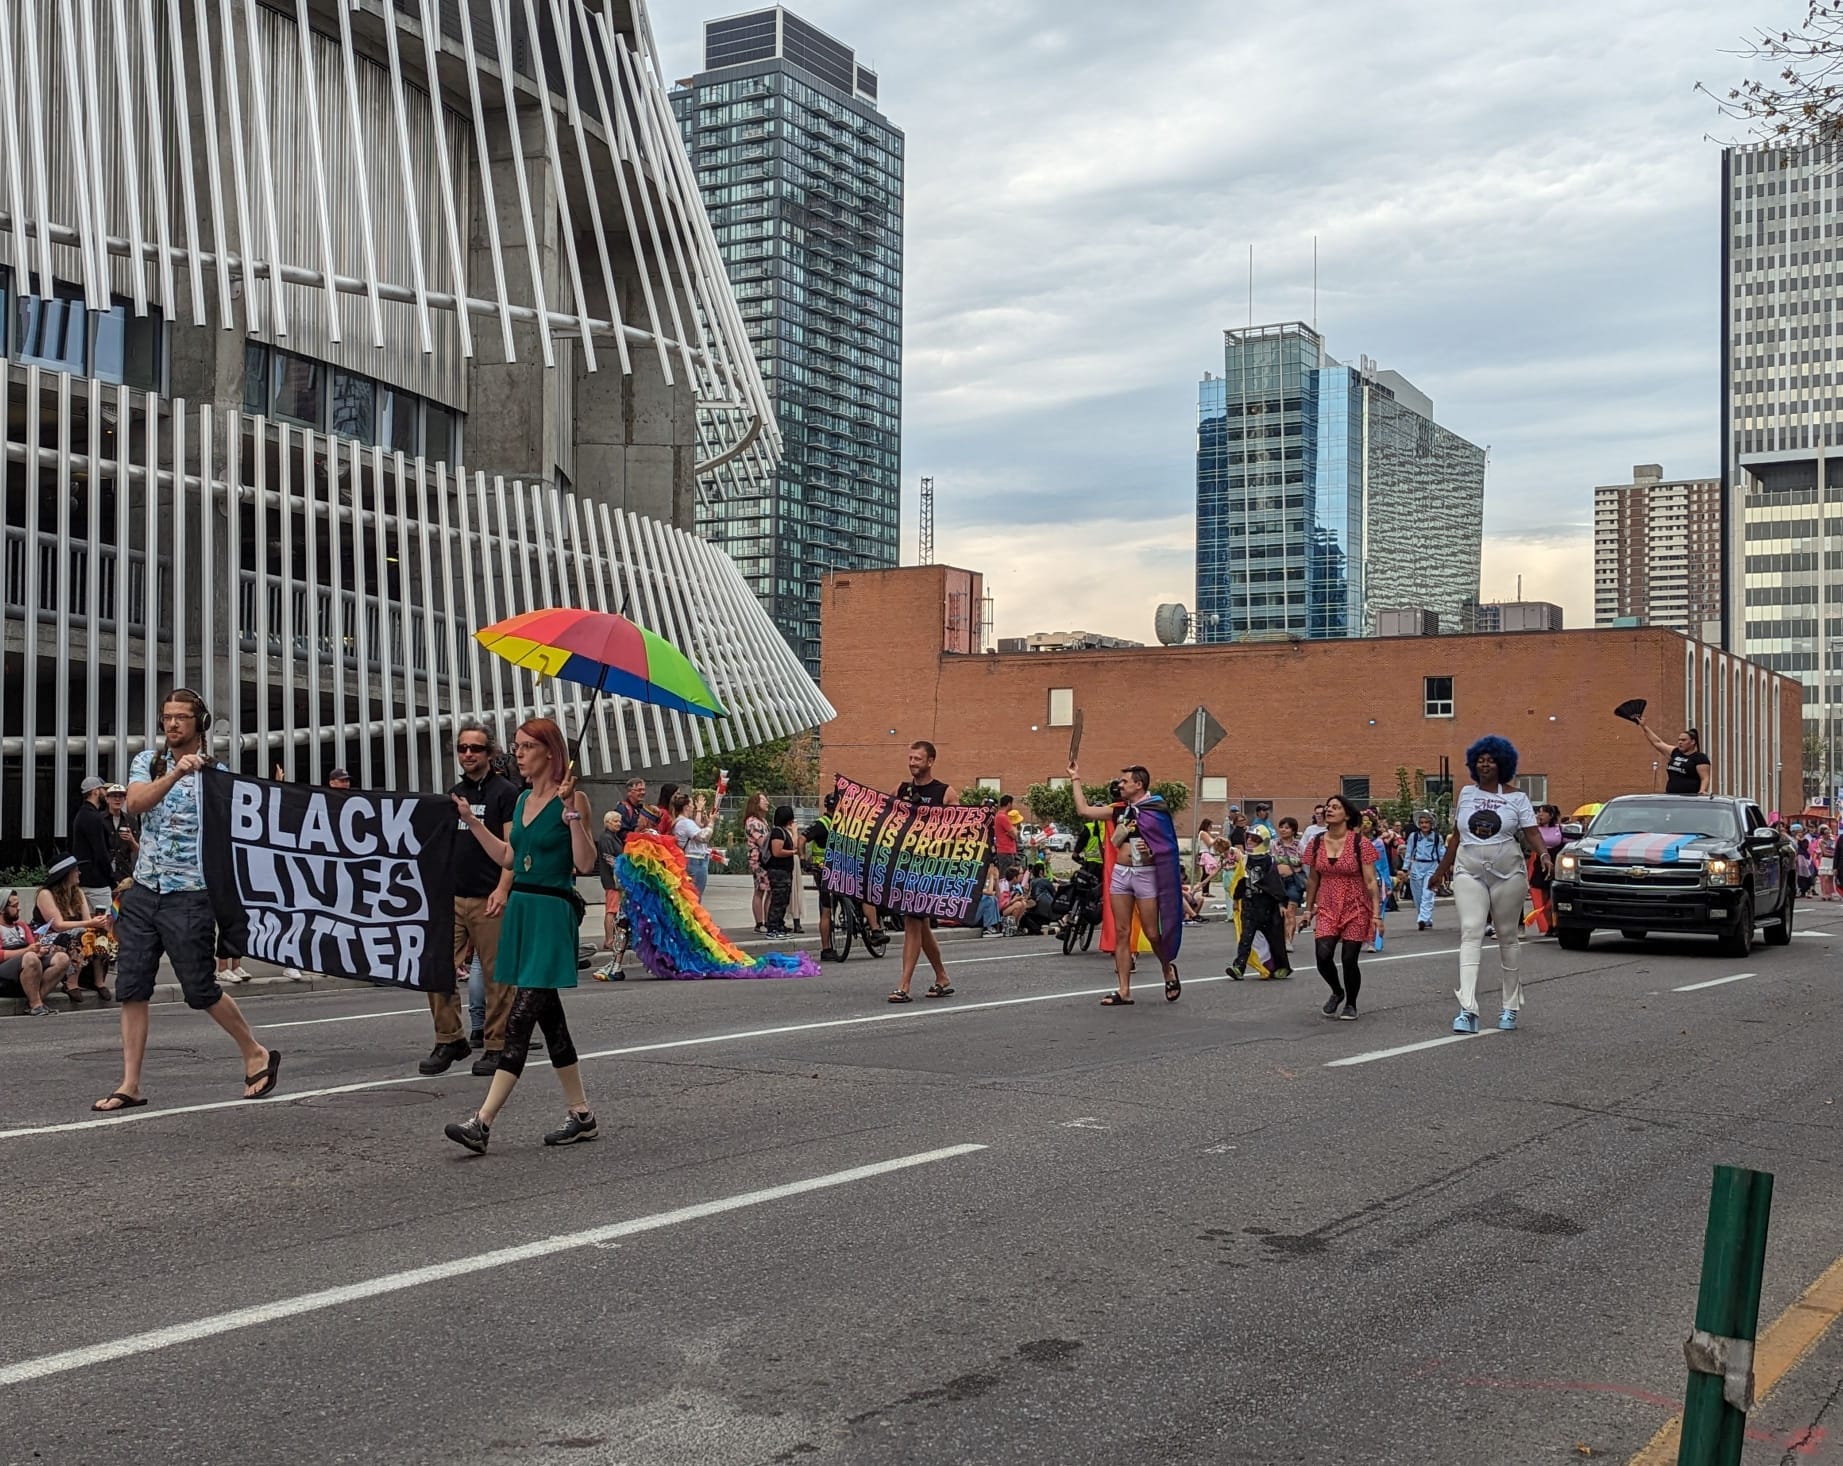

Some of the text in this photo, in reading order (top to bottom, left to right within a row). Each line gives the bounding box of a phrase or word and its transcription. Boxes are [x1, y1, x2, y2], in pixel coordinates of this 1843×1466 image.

[231, 780, 422, 856] BLACK
[837, 777, 890, 813] PRIDE
[890, 800, 912, 818] IS
[881, 813, 906, 831] IS
[826, 831, 984, 879] PRIDE IS PROTEST
[875, 825, 899, 847] IS
[902, 833, 989, 863] PROTEST
[236, 847, 422, 917] LIVES
[821, 867, 973, 919] PRIDE IS PROTEST
[824, 848, 978, 899] PRIDE IS PROTEST
[246, 908, 425, 986] MATTER
